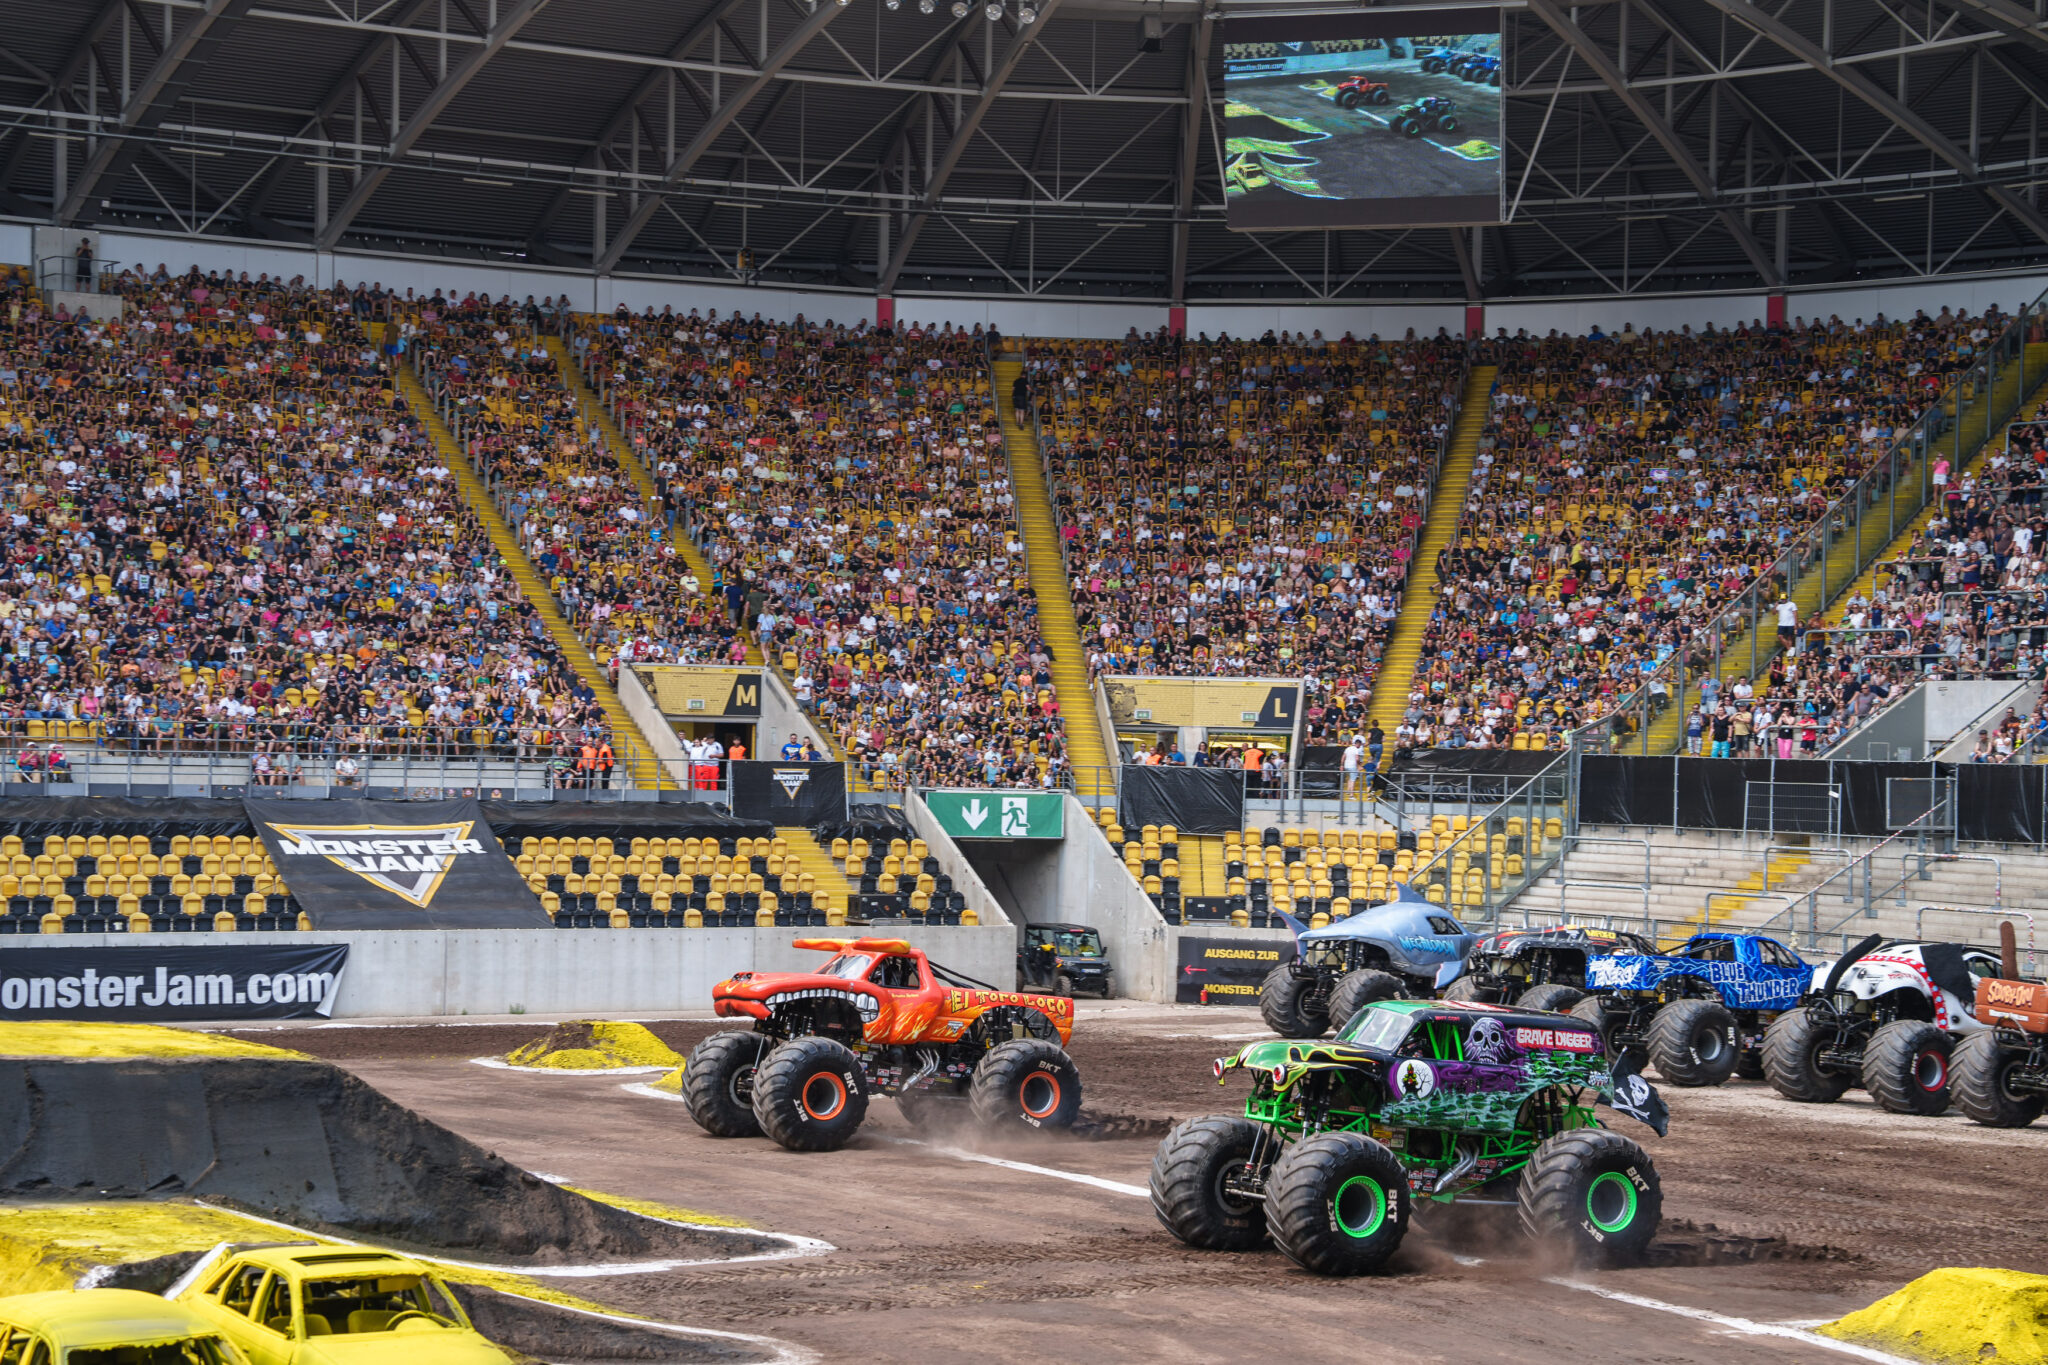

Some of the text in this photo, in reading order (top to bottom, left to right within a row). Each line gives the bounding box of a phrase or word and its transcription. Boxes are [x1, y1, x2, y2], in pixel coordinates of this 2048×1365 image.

[736, 685, 757, 707] M
[1274, 698, 1288, 718] L
[278, 839, 487, 855] MONSTER
[352, 855, 444, 872] JAM
[1204, 948, 1280, 961] AUSGANG ZUR
[1709, 962, 1746, 983] BLUE
[0, 966, 335, 1009] onsterJam.com
[1204, 984, 1263, 996] MONSTER J
[1736, 978, 1800, 1004] THUNDER
[1516, 1028, 1593, 1049] GRAVE DIGGER
[1039, 1060, 1061, 1073] BKT
[844, 1071, 859, 1095] BKT
[793, 1099, 809, 1122] BKT
[1020, 1112, 1041, 1128] BKT
[1625, 1165, 1650, 1193] BKT
[1327, 1199, 1338, 1232] BKT
[1387, 1189, 1398, 1223] BKT
[1580, 1219, 1605, 1243] BKT
